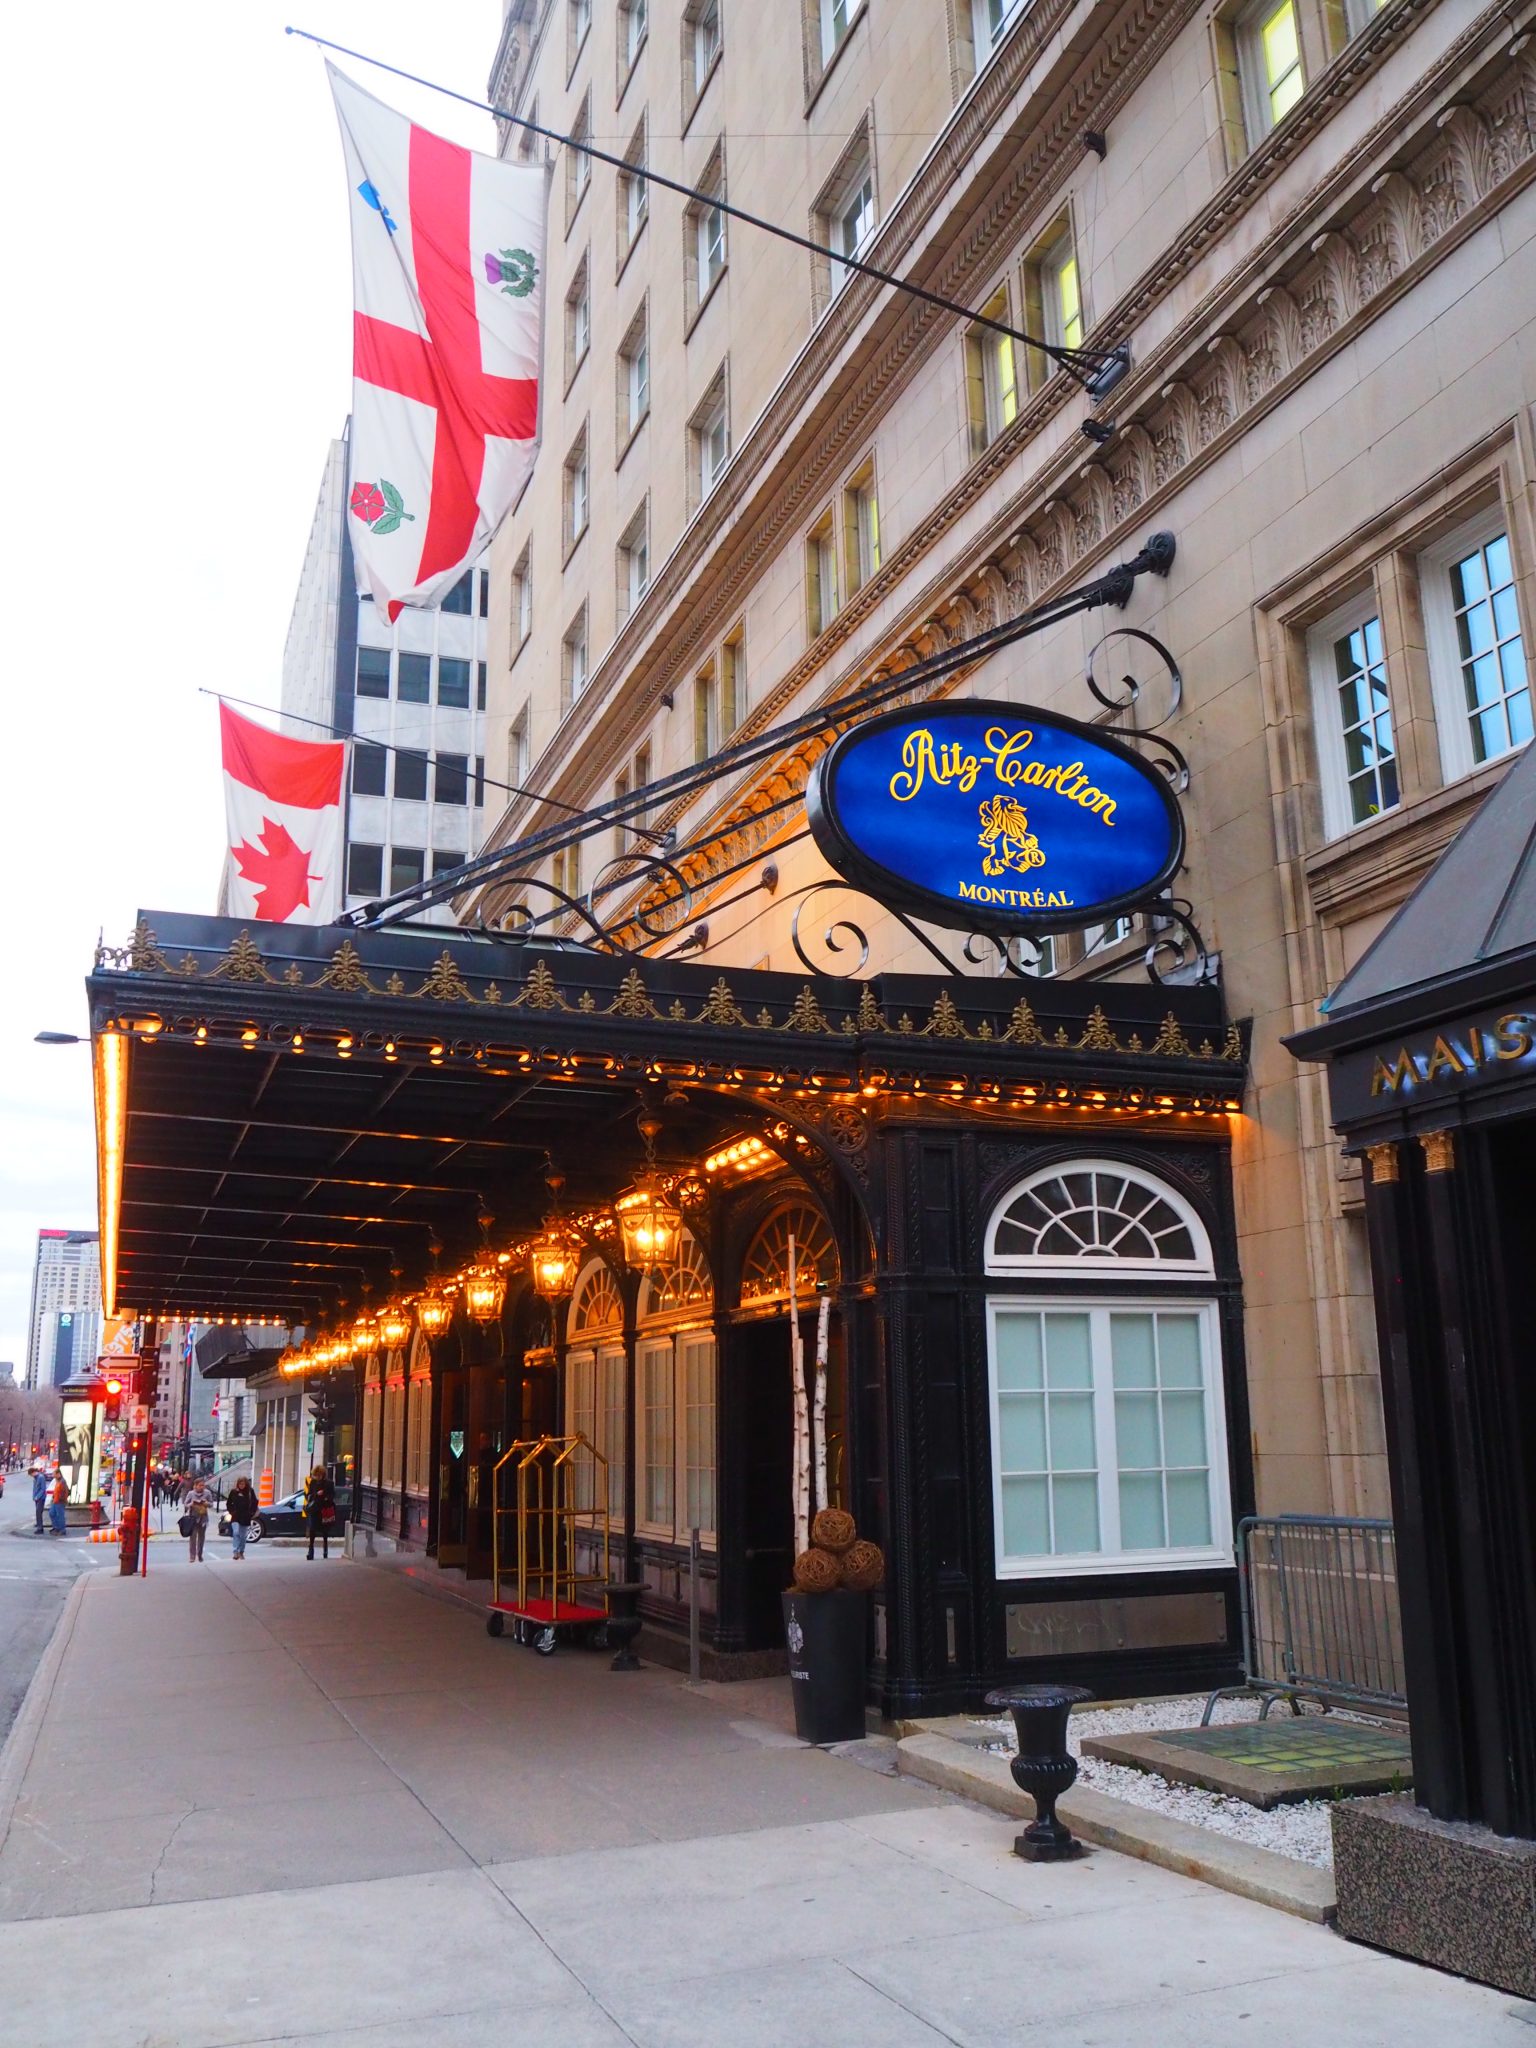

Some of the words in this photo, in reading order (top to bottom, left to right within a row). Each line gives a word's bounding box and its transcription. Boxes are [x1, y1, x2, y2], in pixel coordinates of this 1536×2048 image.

[889, 726, 1116, 827] Ritz-Carlton
[958, 881, 1074, 908] MONTRÉAL
[1370, 1013, 1533, 1096] MAIS
